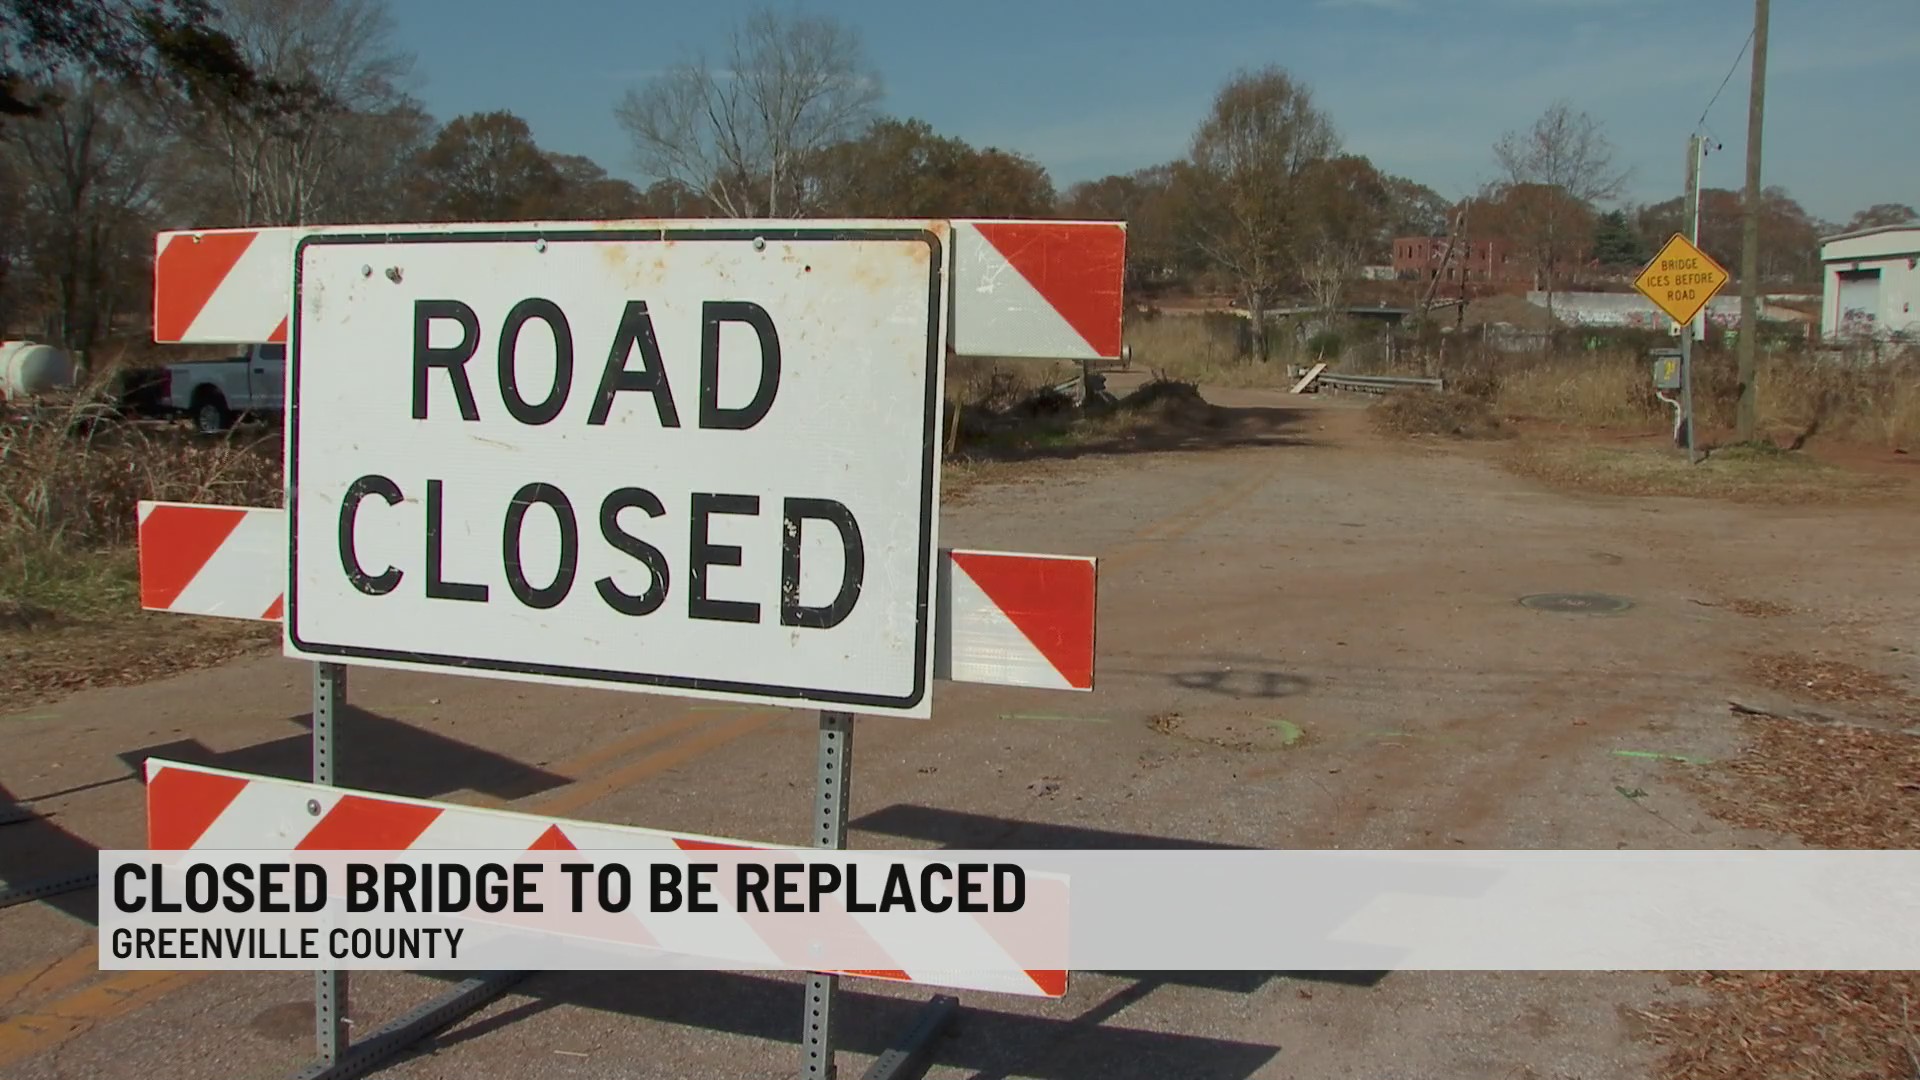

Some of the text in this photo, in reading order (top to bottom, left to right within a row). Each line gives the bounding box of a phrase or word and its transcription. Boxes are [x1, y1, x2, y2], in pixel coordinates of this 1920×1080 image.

[1661, 258, 1699, 271] BRIDGE
[1647, 272, 1714, 288] ICES BEFORE
[1667, 289, 1696, 302] ROAD
[411, 299, 781, 430] ROAD
[338, 475, 865, 630] CLOSED
